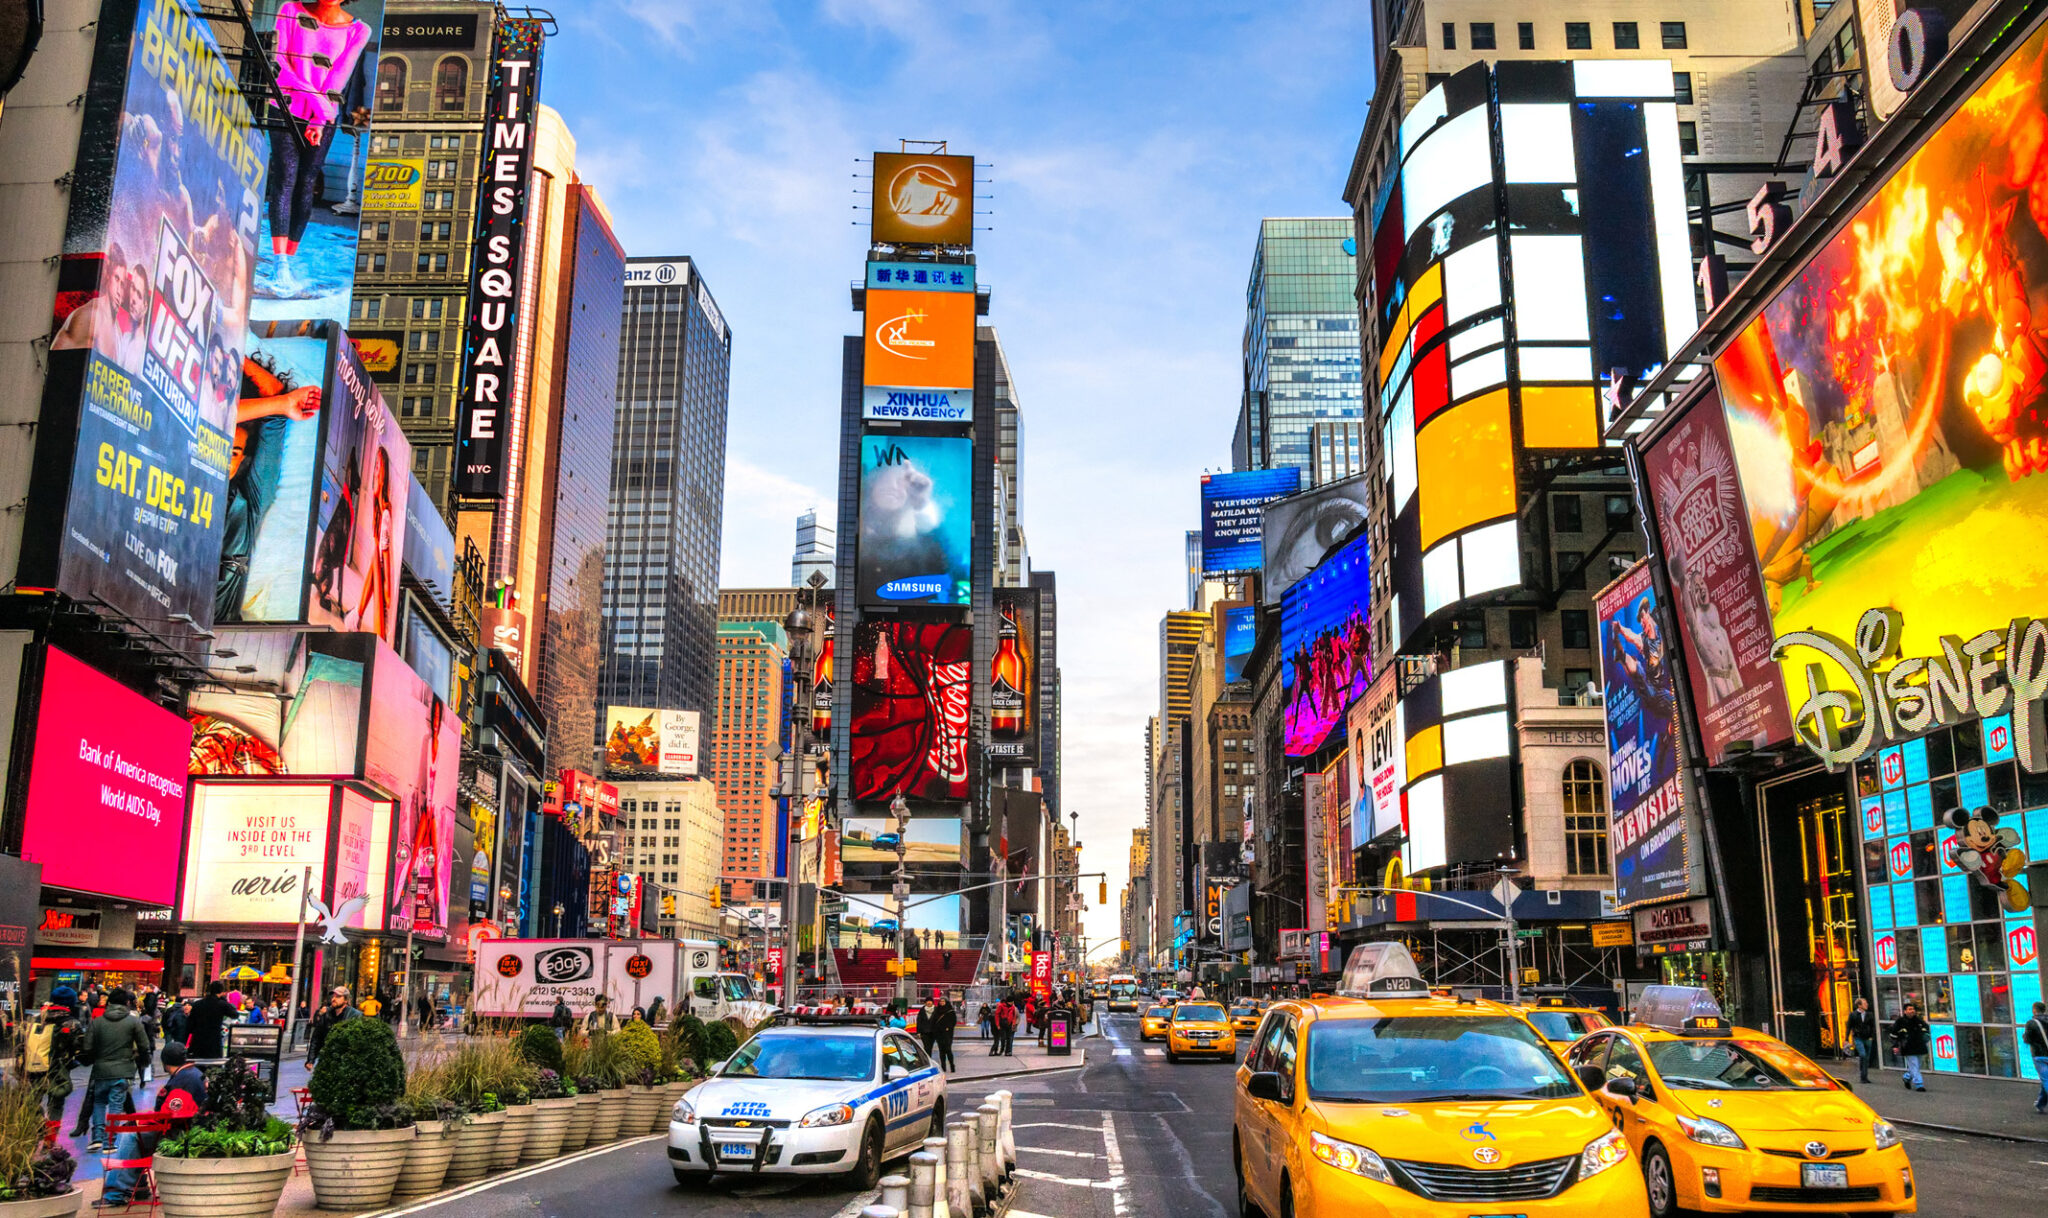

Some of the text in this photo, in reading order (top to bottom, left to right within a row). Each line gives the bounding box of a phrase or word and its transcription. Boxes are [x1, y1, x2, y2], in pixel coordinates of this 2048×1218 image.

[406, 27, 463, 36] SQUARE
[492, 61, 530, 215] TIMES
[156, 226, 212, 348] FOX
[877, 269, 964, 285] 新华通讯社
[151, 302, 201, 395] UFC
[471, 236, 512, 439] SQUARE
[94, 360, 131, 398] FABER
[143, 353, 197, 428] SATURDAY
[338, 351, 366, 420] merry
[90, 380, 152, 432] McDONALD
[887, 392, 950, 407] XINHUA
[873, 406, 965, 418] NEWS AGENCY
[467, 465, 491, 474] NYC
[96, 442, 214, 529] SAT. DEC. 14
[1211, 509, 1246, 518] MATILDA
[1216, 517, 1258, 527] THEY JUST
[1681, 487, 1713, 533] GREAT
[1215, 529, 1240, 537] KNOW
[1684, 506, 1720, 555] COMET
[125, 530, 145, 558] LIVE
[156, 547, 178, 587] FOX
[887, 582, 942, 592] SAMSUNG
[1725, 572, 1742, 594] TALK
[1720, 594, 1732, 611] THE
[1737, 625, 1768, 652] ORIGINAL
[665, 722, 695, 733] George,
[1547, 732, 1573, 744] THE
[1372, 719, 1392, 771] LEVI
[1611, 736, 1637, 768] NOTHING
[79, 738, 183, 800] Bank of America recognizes
[1612, 740, 1652, 800] MOVES
[1638, 772, 1652, 797] LIKE
[100, 784, 161, 827] World AIDS Day.
[246, 816, 296, 828] VISIT US
[227, 831, 312, 843] INSIDE ON THE
[1640, 816, 1683, 861] ON BROADWA
[263, 845, 296, 857] LEVEL
[231, 868, 297, 896] aerie
[1651, 906, 1693, 928] DIGITAL
[1688, 940, 1707, 950] SONY
[547, 954, 582, 976] edge
[769, 950, 781, 974] tkts
[1036, 953, 1051, 978] tkts
[550, 986, 596, 997] 947-3343
[1696, 1018, 1718, 1028] 7L66
[721, 1108, 771, 1117] POLICE
[888, 1089, 909, 1121] NYPD
[722, 1142, 747, 1155] 4135
